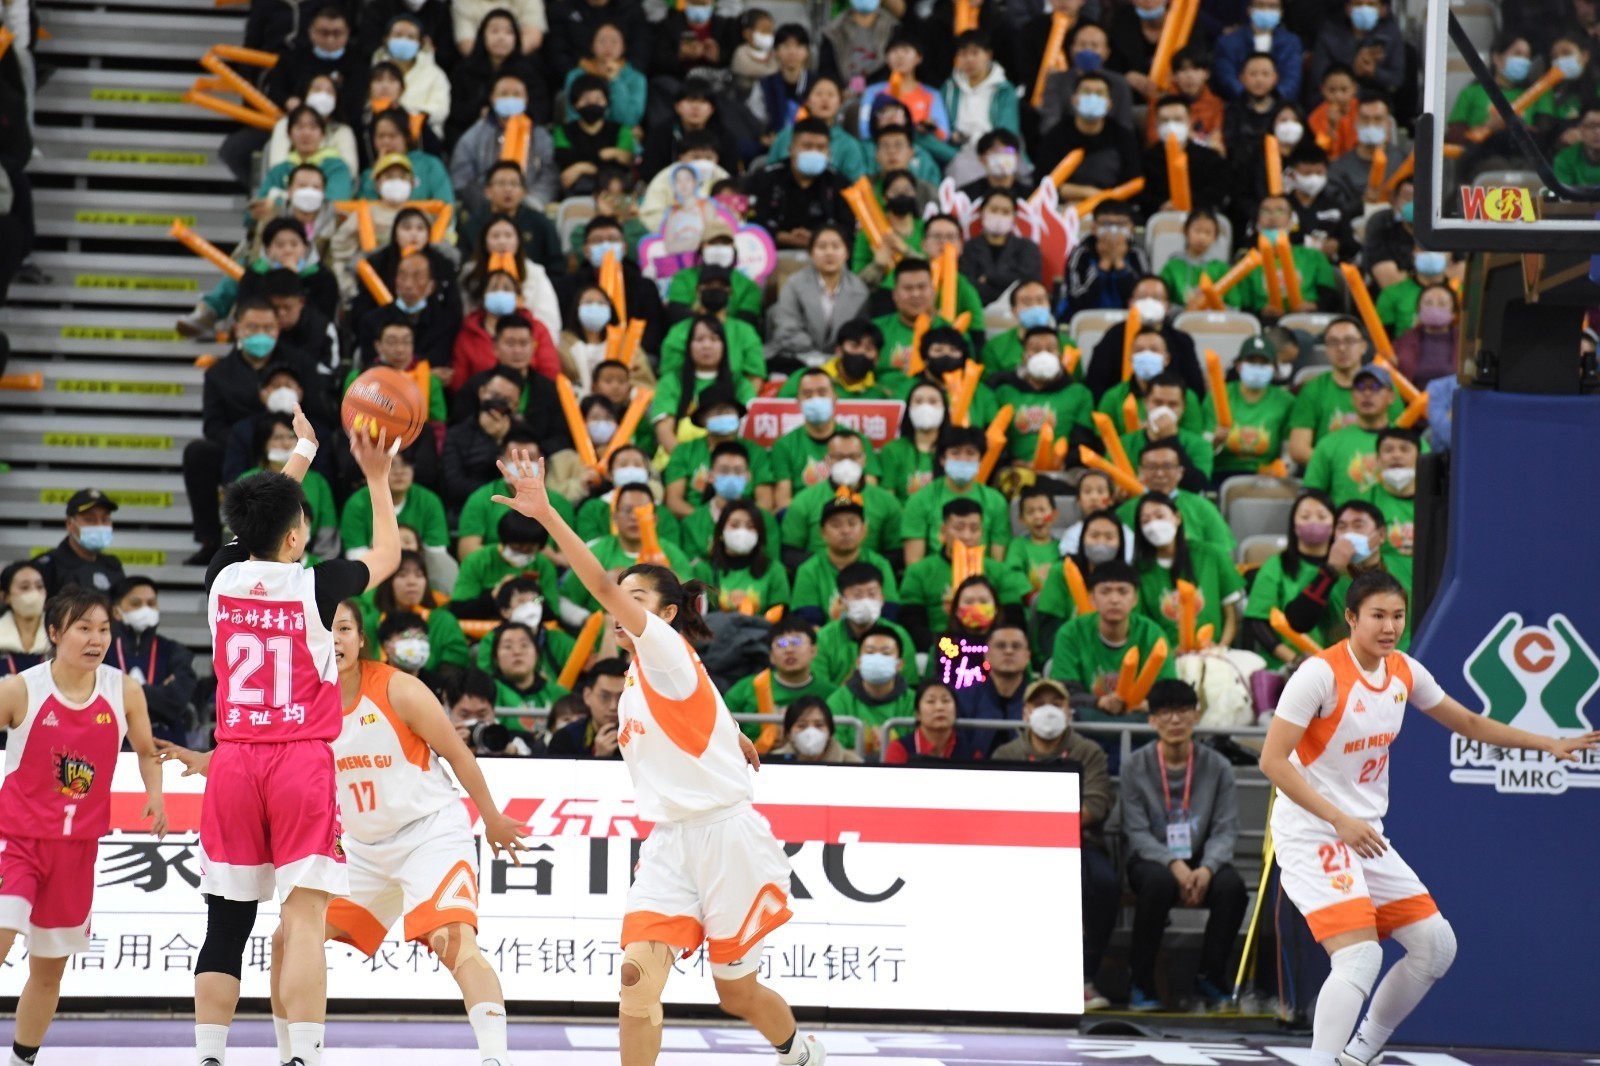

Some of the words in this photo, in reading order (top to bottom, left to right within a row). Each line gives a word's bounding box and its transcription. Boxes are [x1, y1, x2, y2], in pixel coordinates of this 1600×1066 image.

[226, 632, 293, 707] 21
[1343, 737, 1366, 755] NEI
[336, 755, 372, 773] MENG
[374, 755, 392, 769] GU
[1358, 752, 1388, 784] 27
[1501, 769, 1562, 789] IMRC
[348, 781, 376, 813] 17
[63, 804, 77, 836] 1
[1318, 841, 1351, 874] 27
